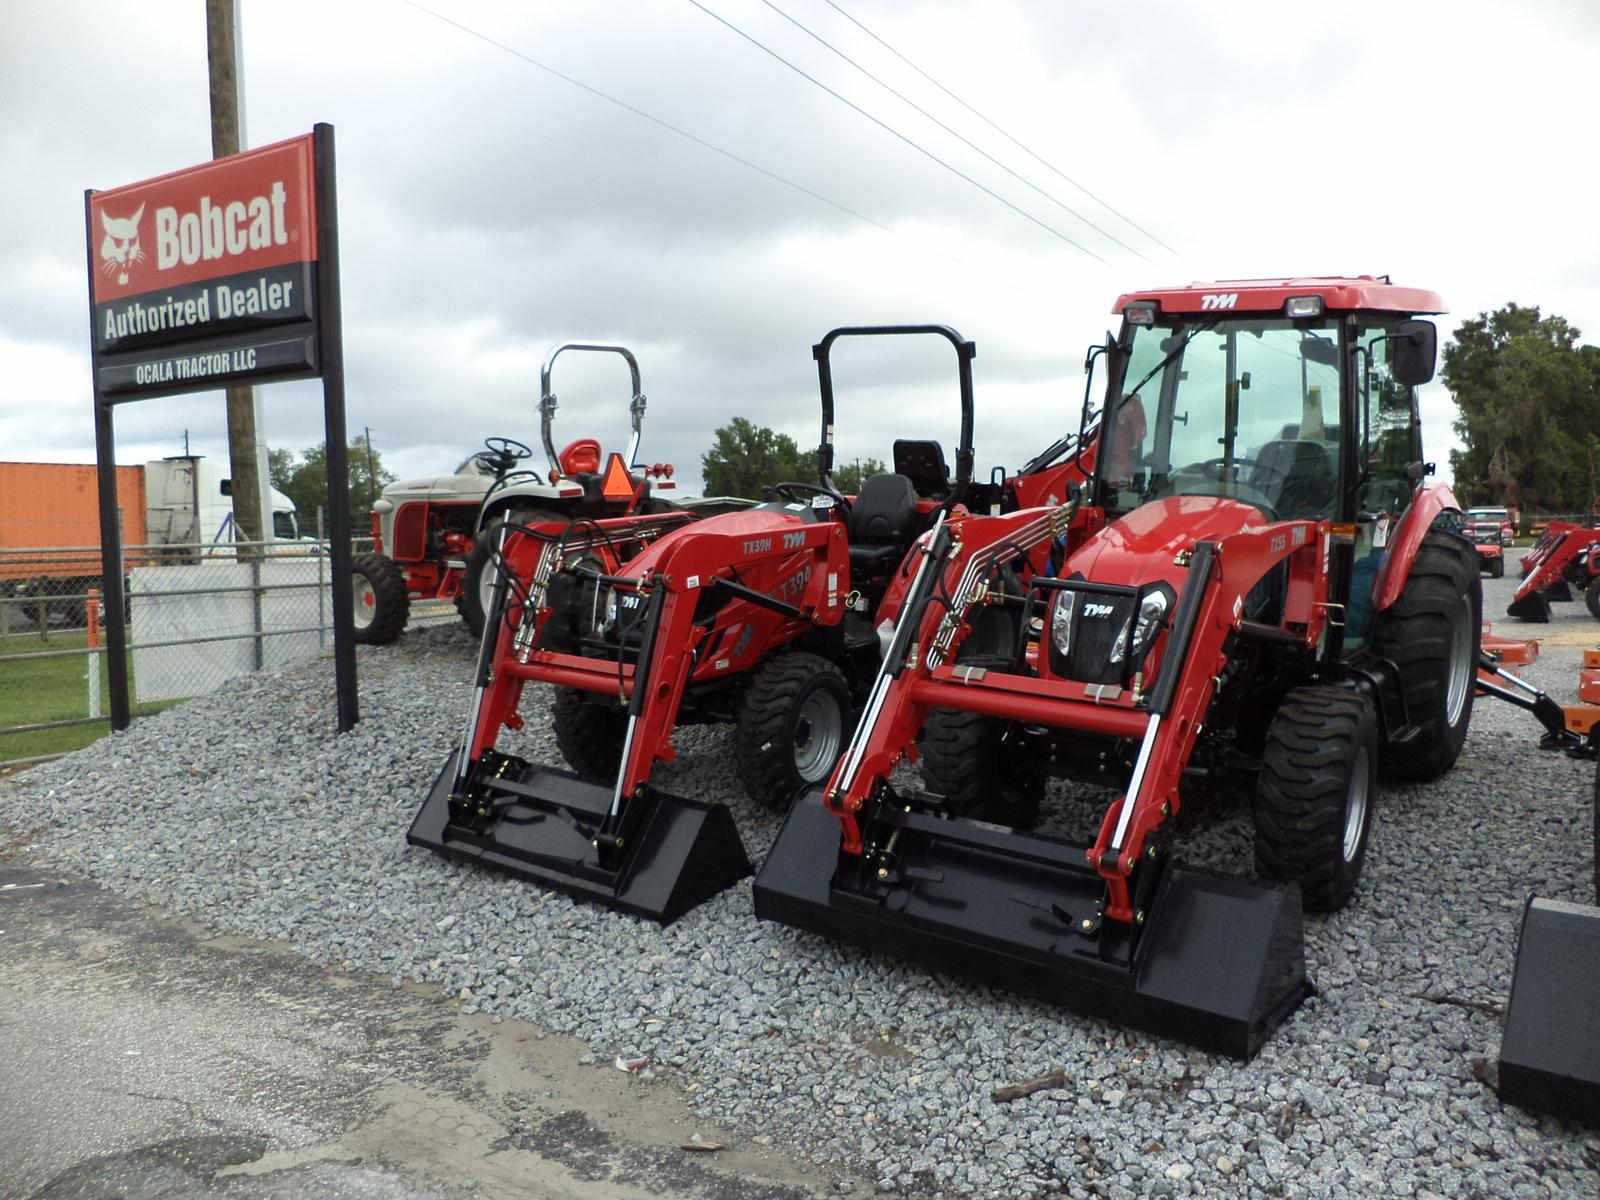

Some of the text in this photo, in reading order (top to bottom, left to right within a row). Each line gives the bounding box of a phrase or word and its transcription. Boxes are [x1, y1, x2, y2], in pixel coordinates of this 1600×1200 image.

[155, 180, 288, 271] Bobcat
[105, 278, 293, 340] Authorized Dealer
[136, 348, 257, 384] OCALA TRACTOR LLC
